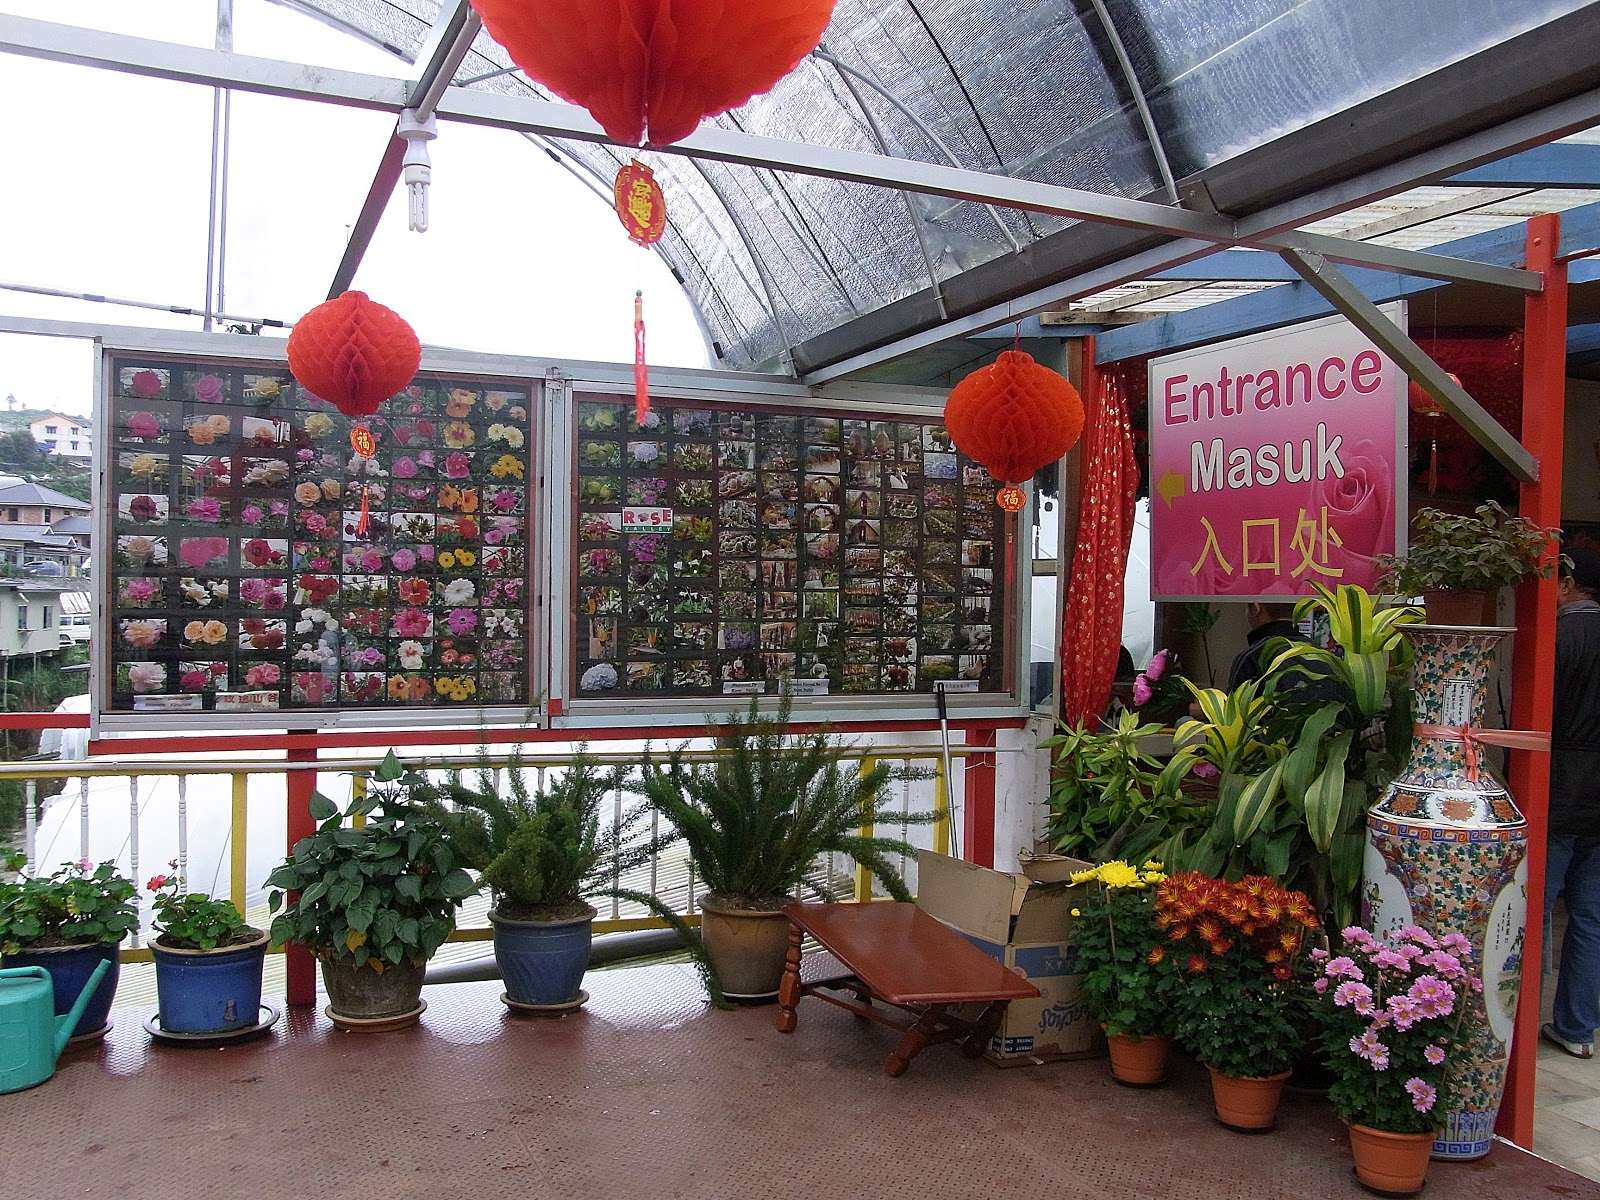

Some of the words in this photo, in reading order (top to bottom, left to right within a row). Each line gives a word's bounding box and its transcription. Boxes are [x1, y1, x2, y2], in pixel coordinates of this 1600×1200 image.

[1164, 349, 1383, 426] Entrance
[1190, 422, 1345, 493] Masuk
[624, 509, 671, 525] ROSE
[1003, 490, 1019, 505] 福
[1190, 506, 1344, 578] 入口处
